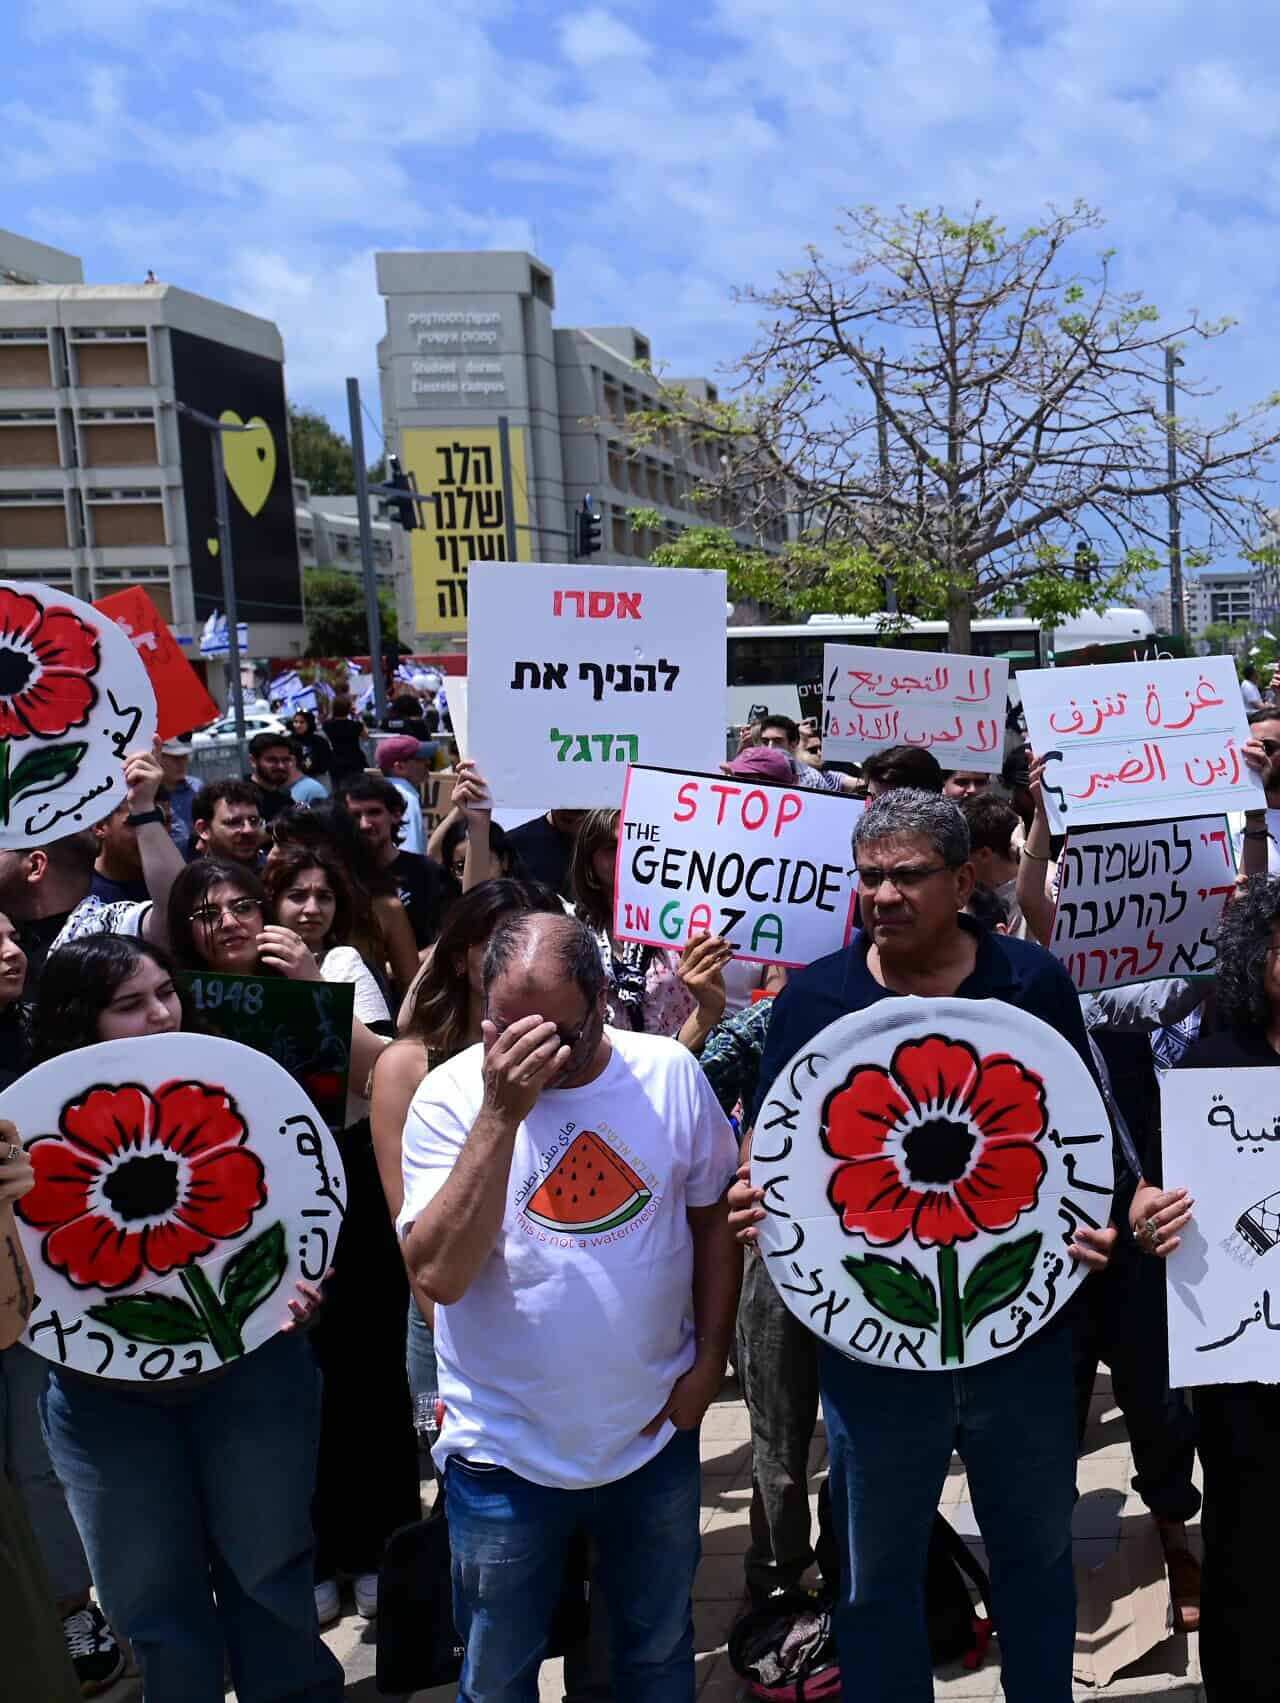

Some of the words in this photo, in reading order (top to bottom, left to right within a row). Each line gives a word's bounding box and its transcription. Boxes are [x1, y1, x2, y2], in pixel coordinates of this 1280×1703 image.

[436, 442, 493, 485] הלב
[432, 487, 504, 530] שלנו
[553, 591, 642, 620] אסרו
[510, 661, 569, 690] את
[578, 659, 680, 701] להניף
[1049, 692, 1128, 736] تنزف
[1145, 674, 1225, 731] غزة
[550, 728, 639, 762] הדגל
[624, 822, 661, 842] THE
[673, 782, 803, 838] STOP
[631, 845, 844, 912] GENOCIDE
[1063, 824, 1193, 888] להשמדה
[624, 903, 650, 931] IN
[659, 900, 783, 954] GAZA
[1056, 881, 1188, 941] להרעבה
[191, 978, 265, 1016] 1948
[515, 1212, 535, 1237] This
[550, 1236, 575, 1250] not
[578, 1239, 588, 1249] a
[590, 1195, 664, 1249] watermelon
[29, 1288, 204, 1380] נסירא
[848, 1315, 927, 1369] אום
